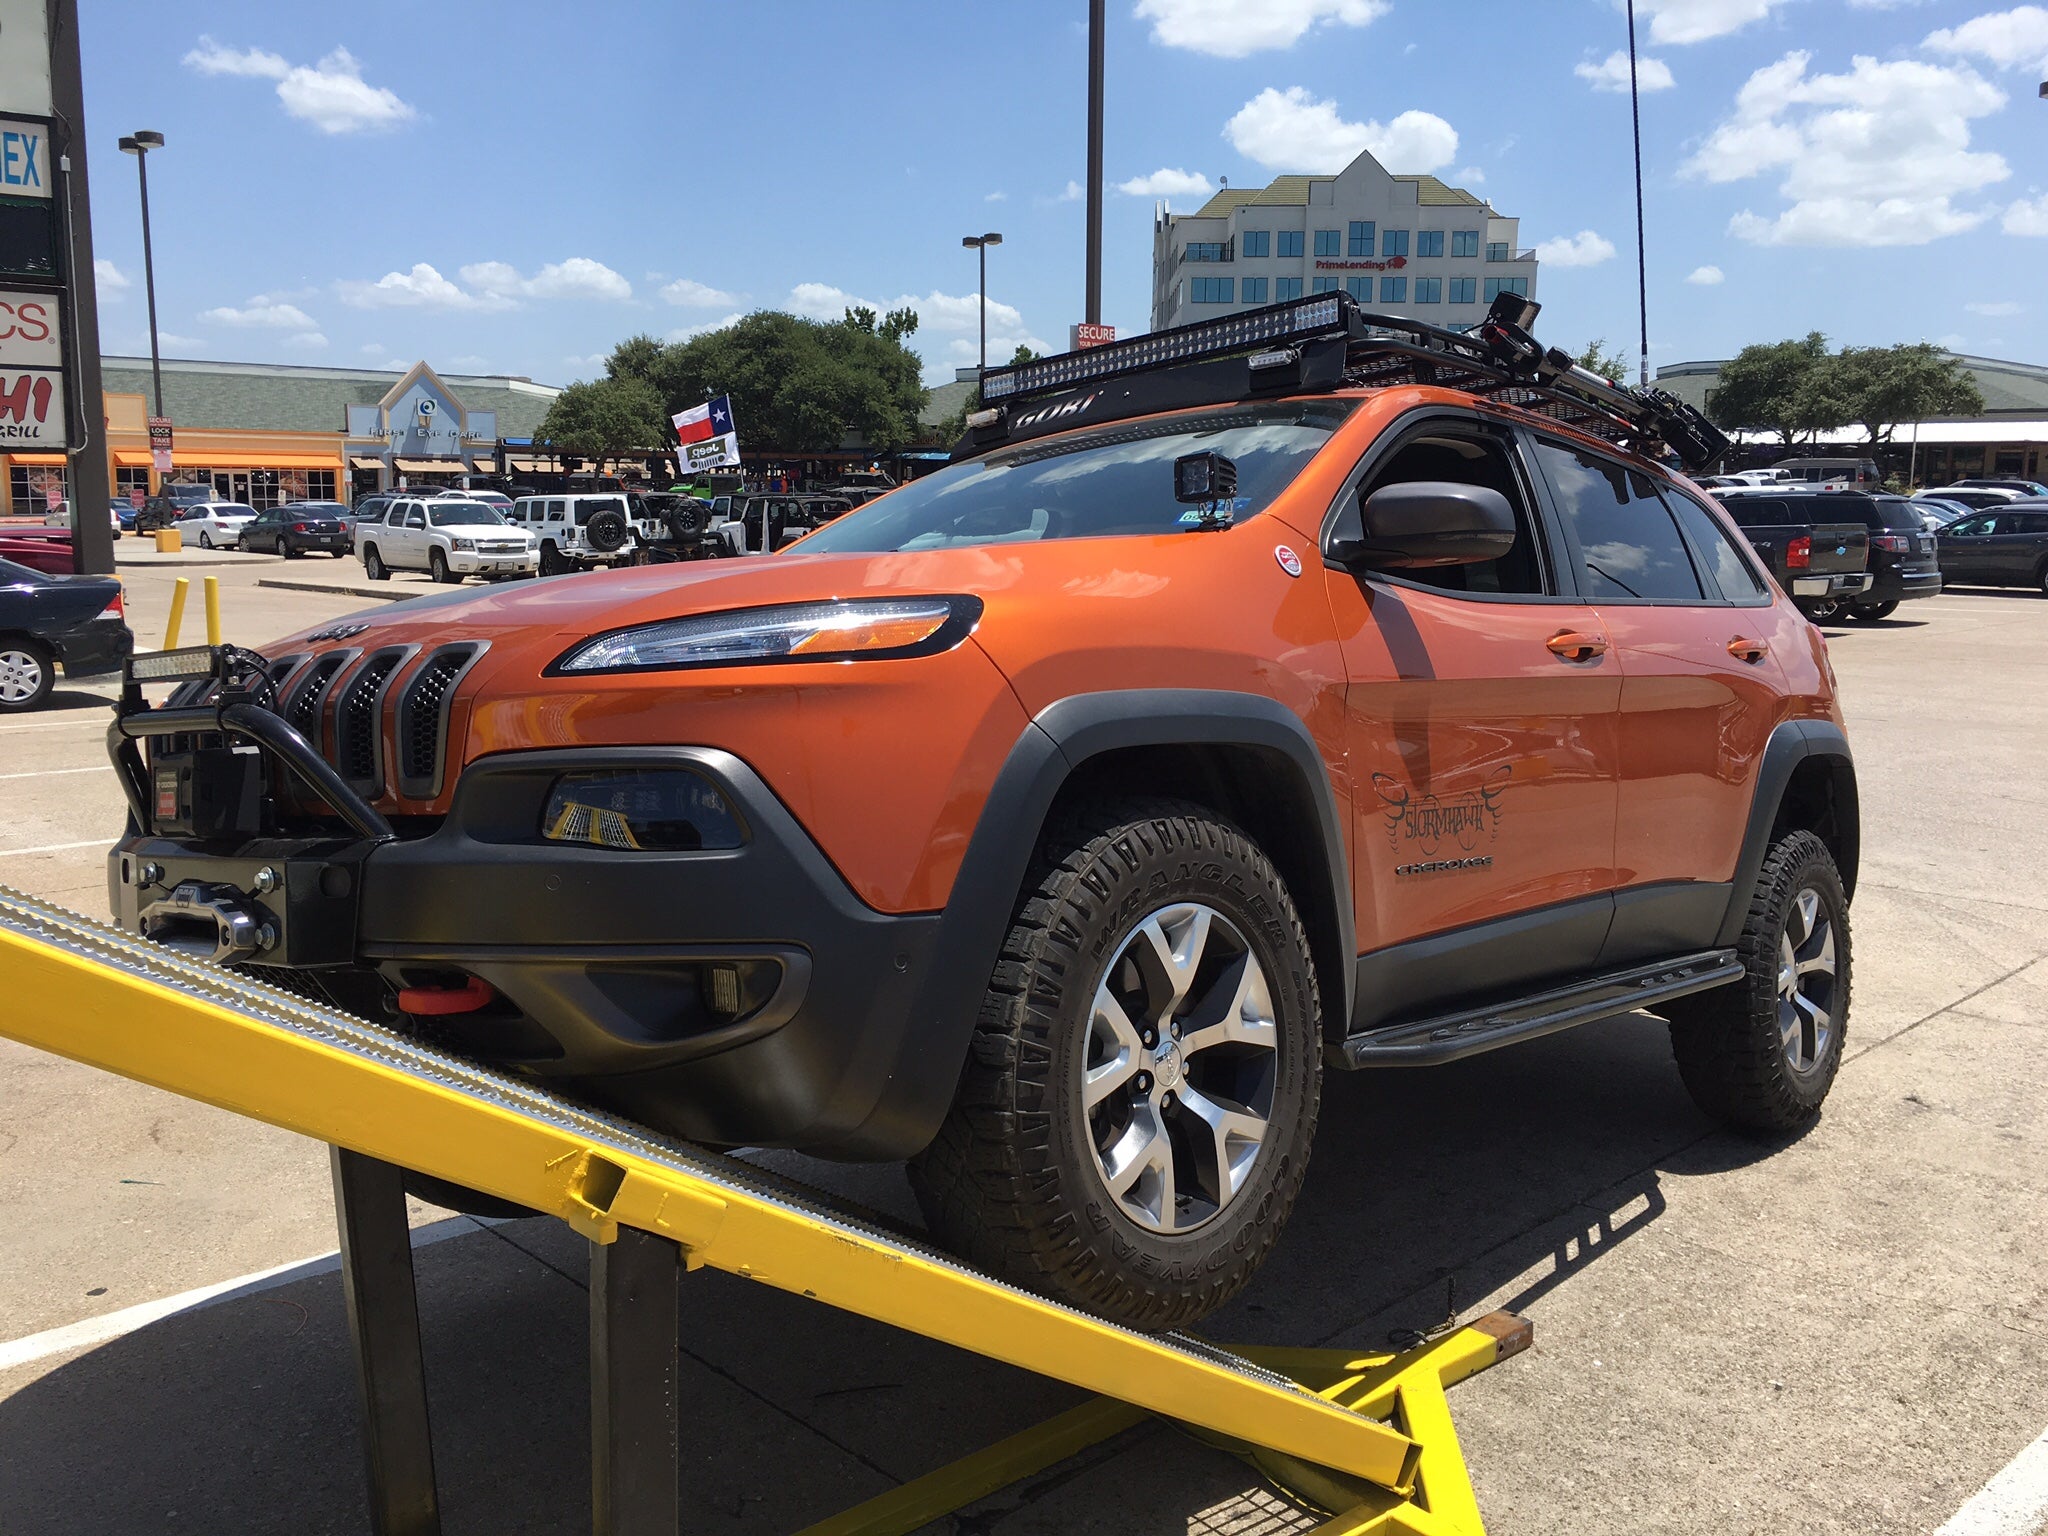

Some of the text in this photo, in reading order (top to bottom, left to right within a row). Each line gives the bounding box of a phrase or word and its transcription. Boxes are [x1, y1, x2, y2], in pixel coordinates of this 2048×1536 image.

[0, 131, 40, 187] EX
[1316, 260, 1386, 271] PrimeLending
[1078, 325, 1115, 341] SECURE
[1395, 855, 1494, 877] CHEROKEE
[1091, 861, 1287, 960] WRANGLER
